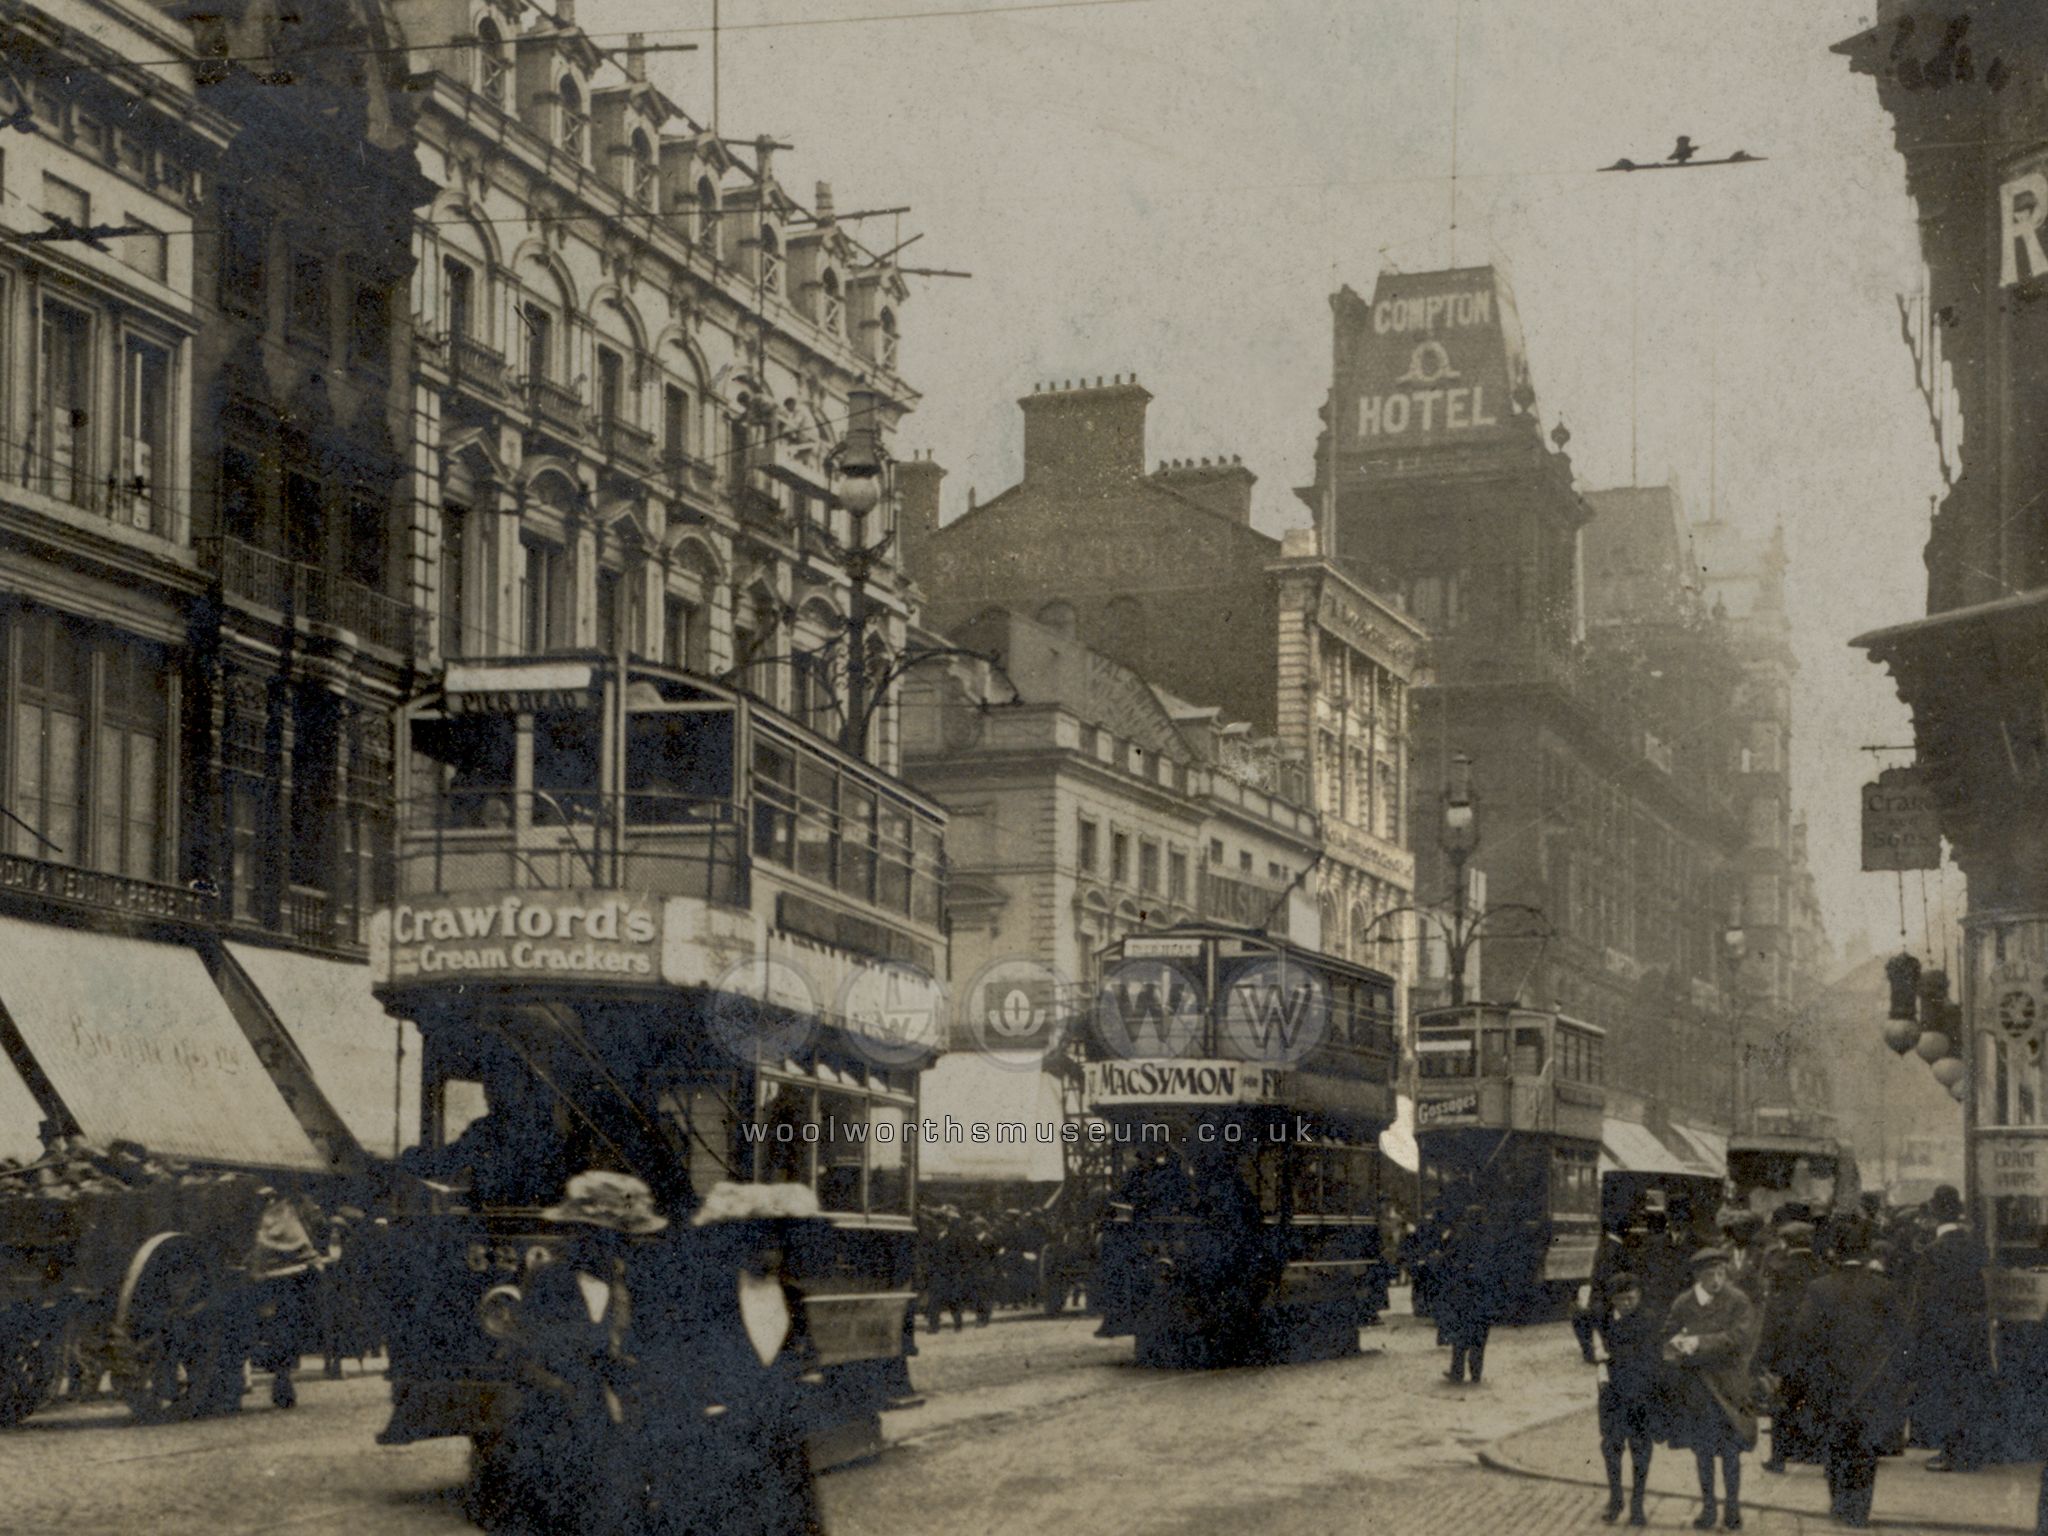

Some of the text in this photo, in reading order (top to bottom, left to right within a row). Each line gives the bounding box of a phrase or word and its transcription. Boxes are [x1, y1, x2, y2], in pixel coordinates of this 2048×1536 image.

[1373, 289, 1490, 335] COMPTON
[1358, 386, 1497, 437] HOTEL
[0, 859, 36, 890] DAY
[393, 896, 657, 945] Crawford's
[420, 943, 512, 974] Cream
[514, 941, 652, 976] Crackers
